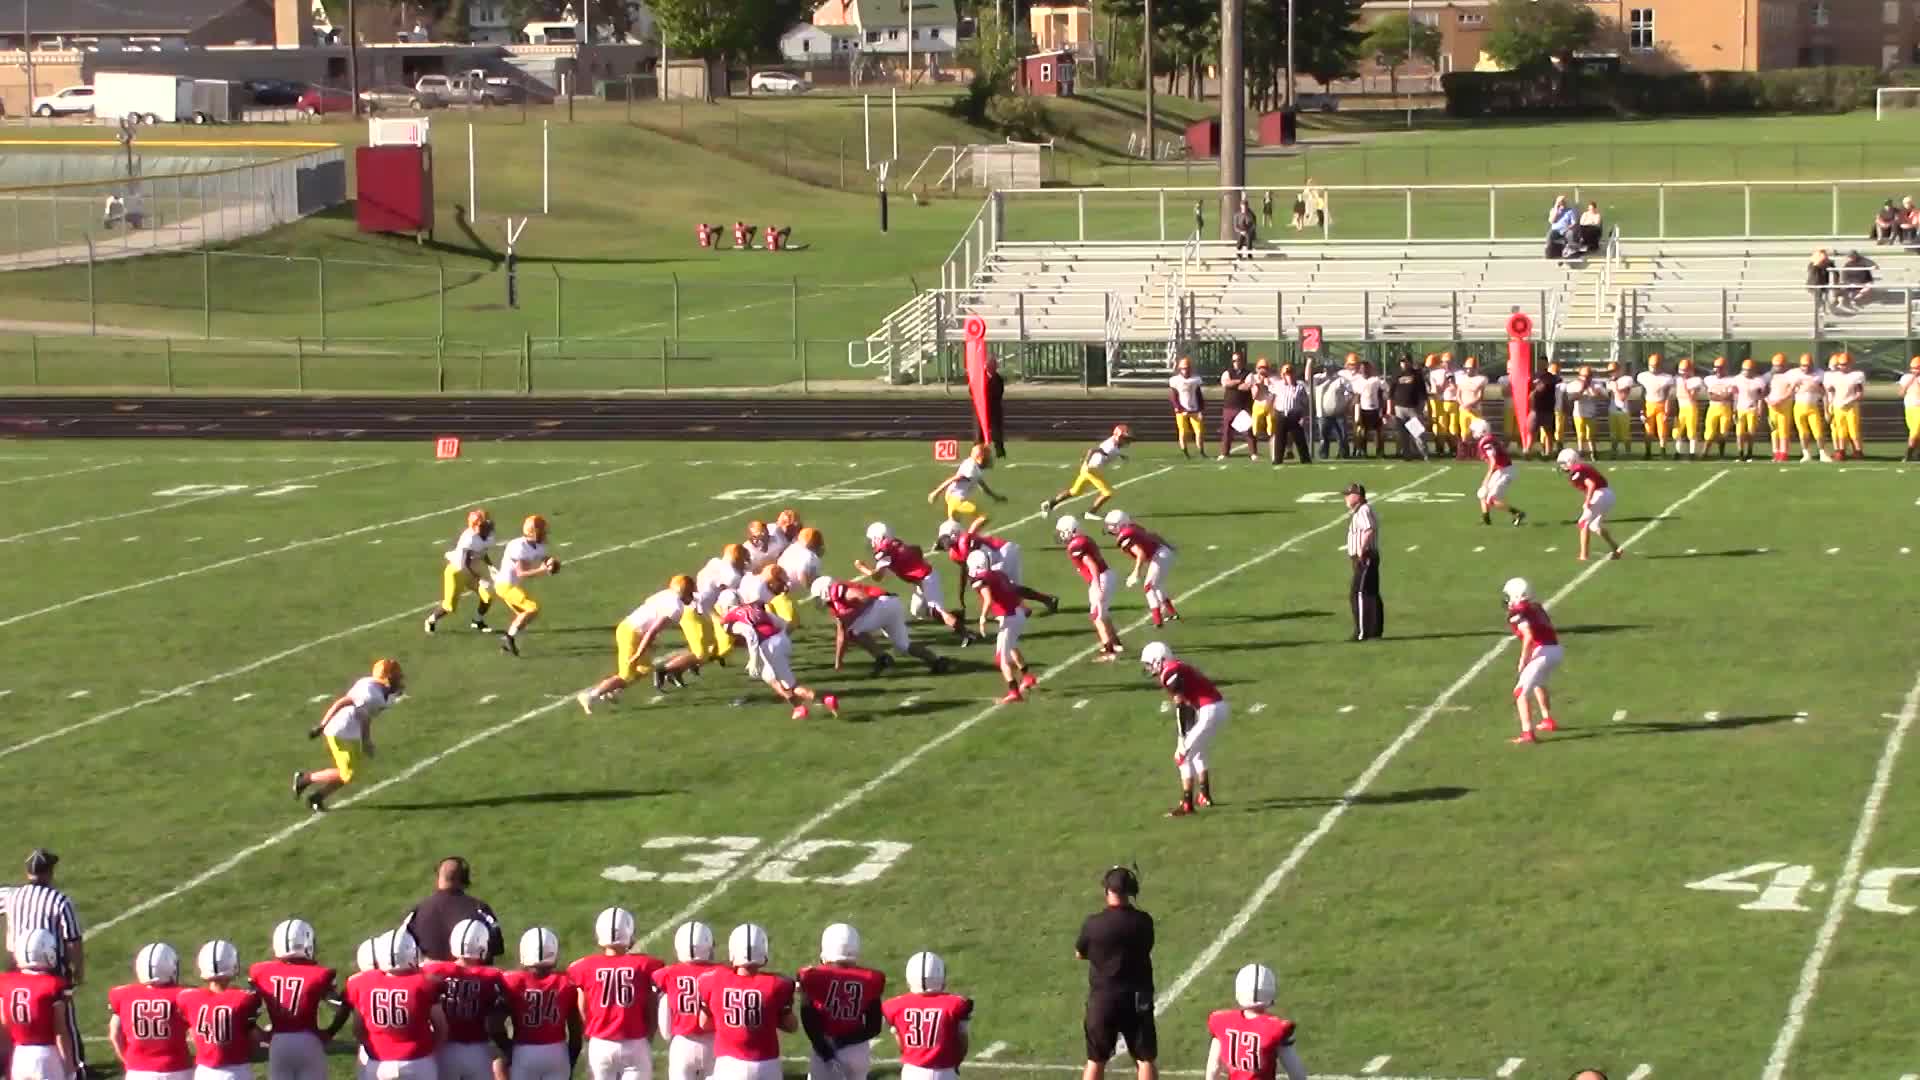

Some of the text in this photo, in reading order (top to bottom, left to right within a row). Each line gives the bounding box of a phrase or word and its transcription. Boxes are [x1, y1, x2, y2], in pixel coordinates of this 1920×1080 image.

[1302, 327, 1320, 352] 2
[937, 441, 956, 458] 20
[600, 836, 914, 885] 30
[10, 987, 32, 1025] 6
[270, 975, 305, 1017] 17
[523, 988, 559, 1027] 34
[595, 966, 635, 1008] 76
[676, 975, 700, 1016] 2
[824, 979, 864, 1020] 43
[131, 999, 171, 1040] 62
[196, 1004, 233, 1044] 40
[370, 988, 409, 1028] 66
[723, 987, 763, 1029] 58
[904, 1007, 943, 1049] 37
[1225, 1028, 1261, 1072] 13
